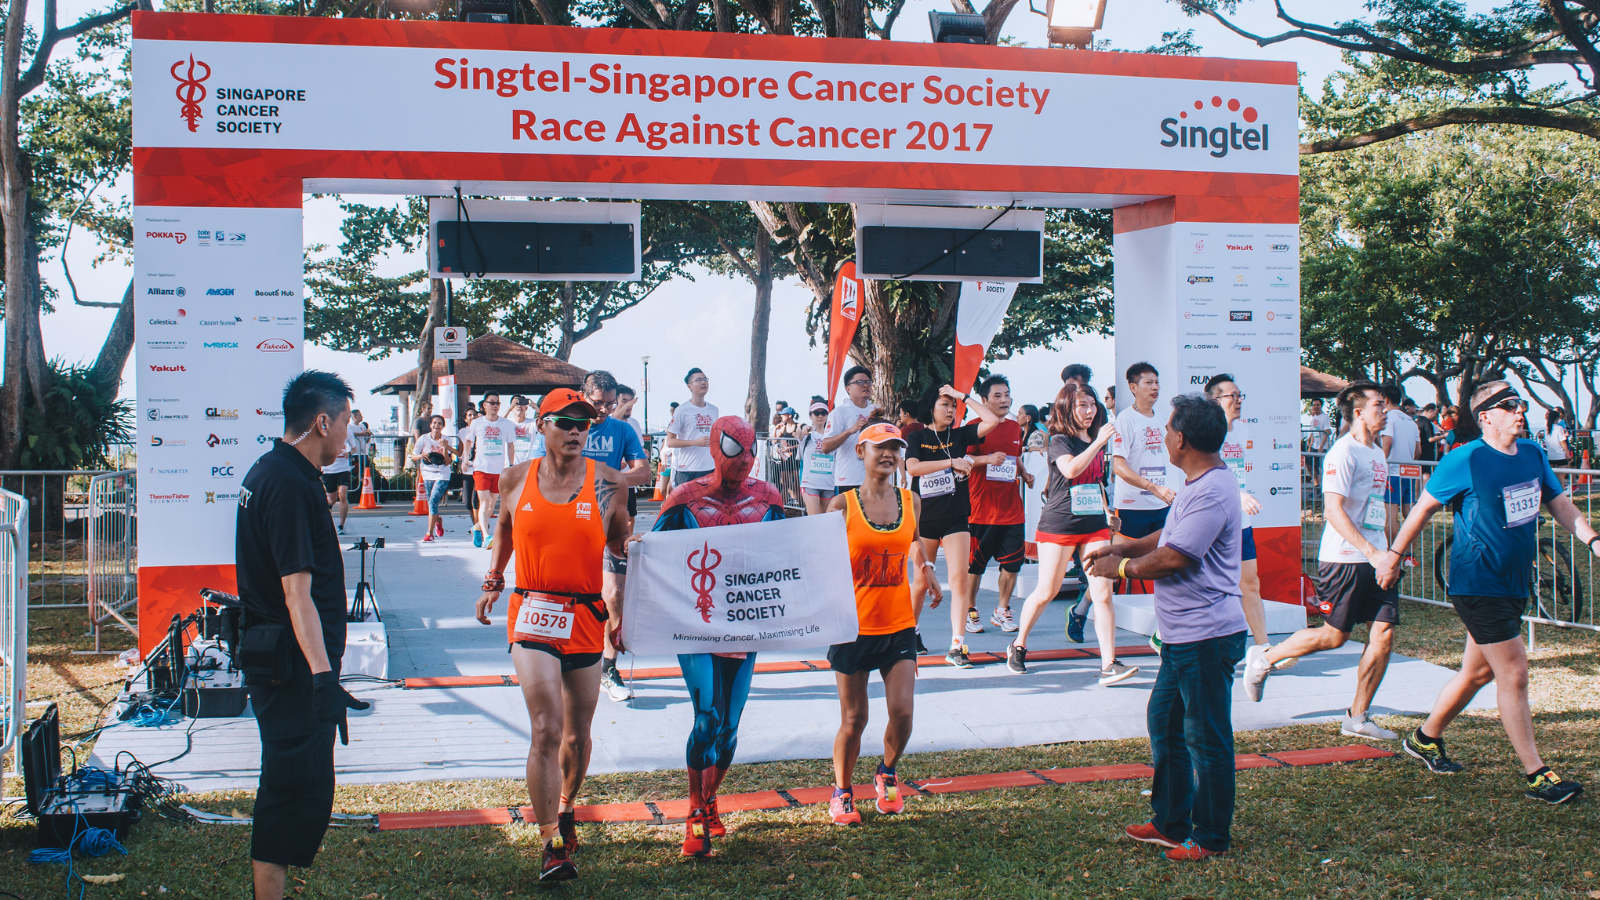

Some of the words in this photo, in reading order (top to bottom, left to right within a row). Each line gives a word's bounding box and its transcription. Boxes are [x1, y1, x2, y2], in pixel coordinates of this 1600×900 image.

[434, 57, 779, 103] Singtel-Singapore
[787, 70, 915, 104] Cancer
[922, 75, 1051, 115] Society
[216, 88, 306, 102] SINGAPORE
[216, 104, 279, 117] CANCER
[216, 121, 282, 134] SOCIETY
[512, 109, 606, 142] Race
[615, 112, 760, 151] Against
[769, 117, 897, 149] Cancer
[906, 120, 994, 152] 2017
[1160, 117, 1269, 159] Singtel
[146, 231, 174, 239] POKKA
[147, 287, 175, 296] Allianz
[149, 364, 187, 372] Yakult
[221, 438, 239, 446] MFS
[211, 466, 235, 476] PCC
[922, 476, 951, 489] 40980
[724, 567, 801, 587] SINGAPORE
[726, 587, 782, 604] CANCER
[522, 611, 568, 629] 10578
[727, 604, 786, 622] SOCIETY
[672, 633, 721, 643] Minimising
[759, 626, 804, 640] Maximising
[805, 624, 820, 634] Life
